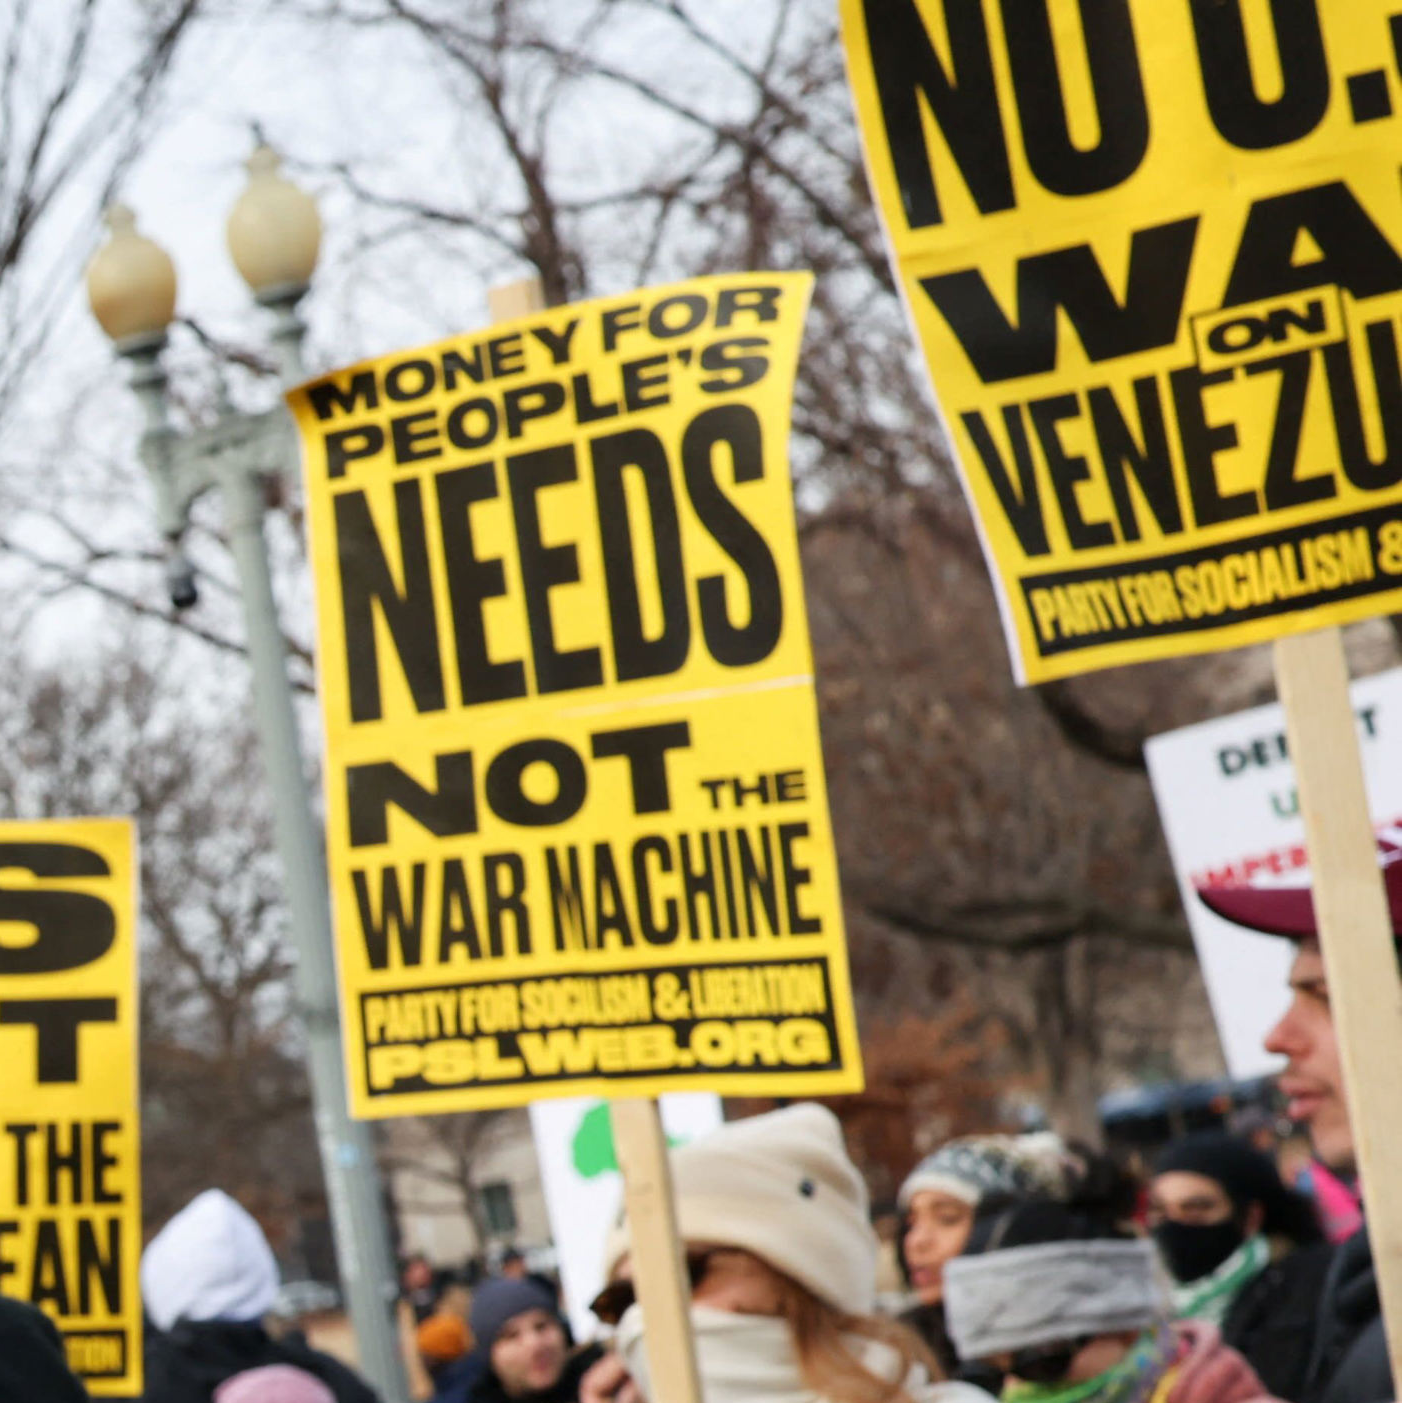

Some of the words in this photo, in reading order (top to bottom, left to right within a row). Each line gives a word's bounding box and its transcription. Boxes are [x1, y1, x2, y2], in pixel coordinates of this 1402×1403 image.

[859, 0, 1150, 230] NO
[1190, 0, 1402, 150] U.
[918, 162, 1402, 384] WA
[1207, 299, 1326, 354] ON
[304, 316, 583, 421] MONEY
[600, 285, 785, 353] FOR
[323, 336, 772, 479] PEOPLE'S
[330, 401, 785, 725] NEEDS
[1030, 582, 1128, 643] PARTY
[1118, 569, 1183, 627] FOR
[1174, 526, 1376, 620] SOCIALISM
[345, 719, 692, 848] NOT
[699, 768, 808, 810] THE
[351, 850, 533, 971] WAR
[543, 821, 823, 952] MACHINE
[365, 985, 460, 1044] PARTY
[460, 982, 521, 1037] FOR
[653, 971, 691, 1022] &
[689, 963, 828, 1018] LIBERATION
[366, 1017, 833, 1091] PSLWEB.ORG
[5, 1120, 124, 1207] THE
